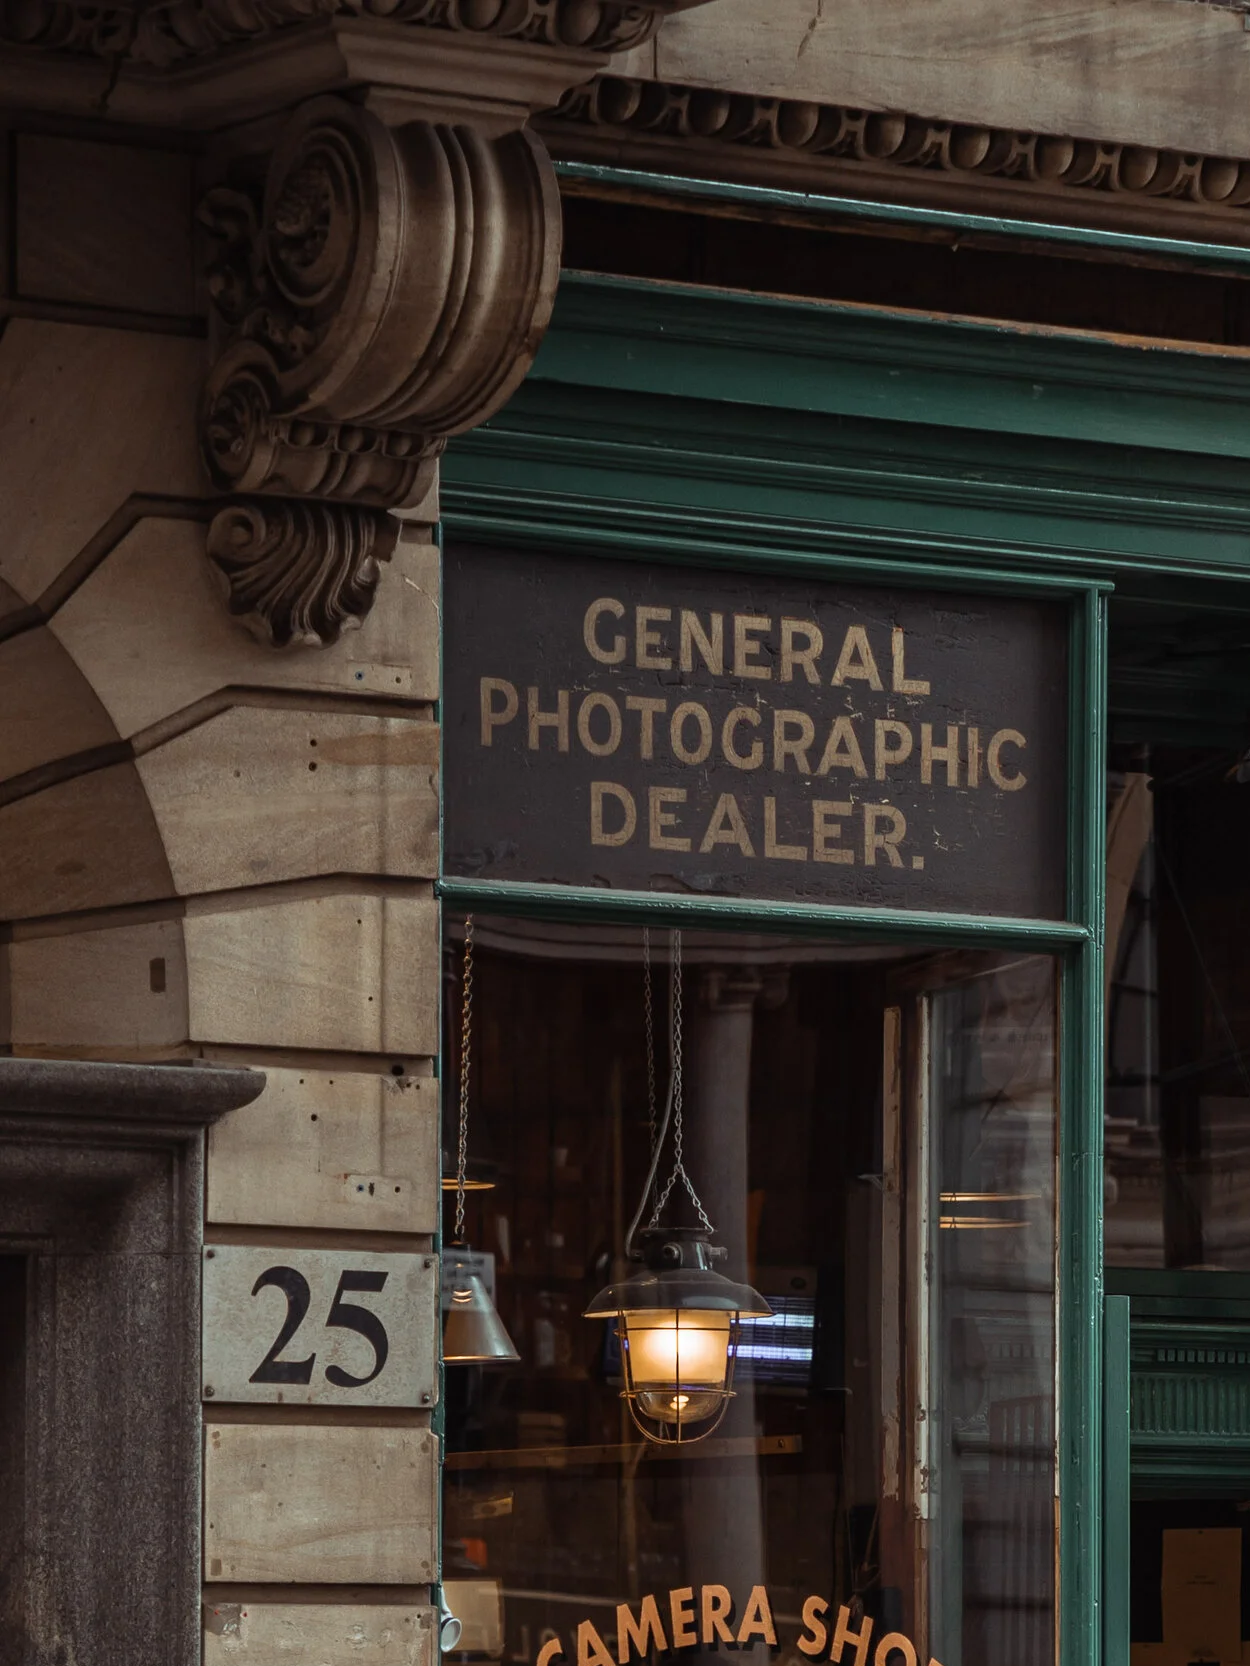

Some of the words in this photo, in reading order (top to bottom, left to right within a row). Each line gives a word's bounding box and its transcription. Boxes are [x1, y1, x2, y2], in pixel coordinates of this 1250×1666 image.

[583, 597, 931, 696] GENERAL
[479, 676, 1027, 791] PHOTOGRAPHIC
[590, 781, 925, 871] DEALER.
[249, 1266, 389, 1388] 25
